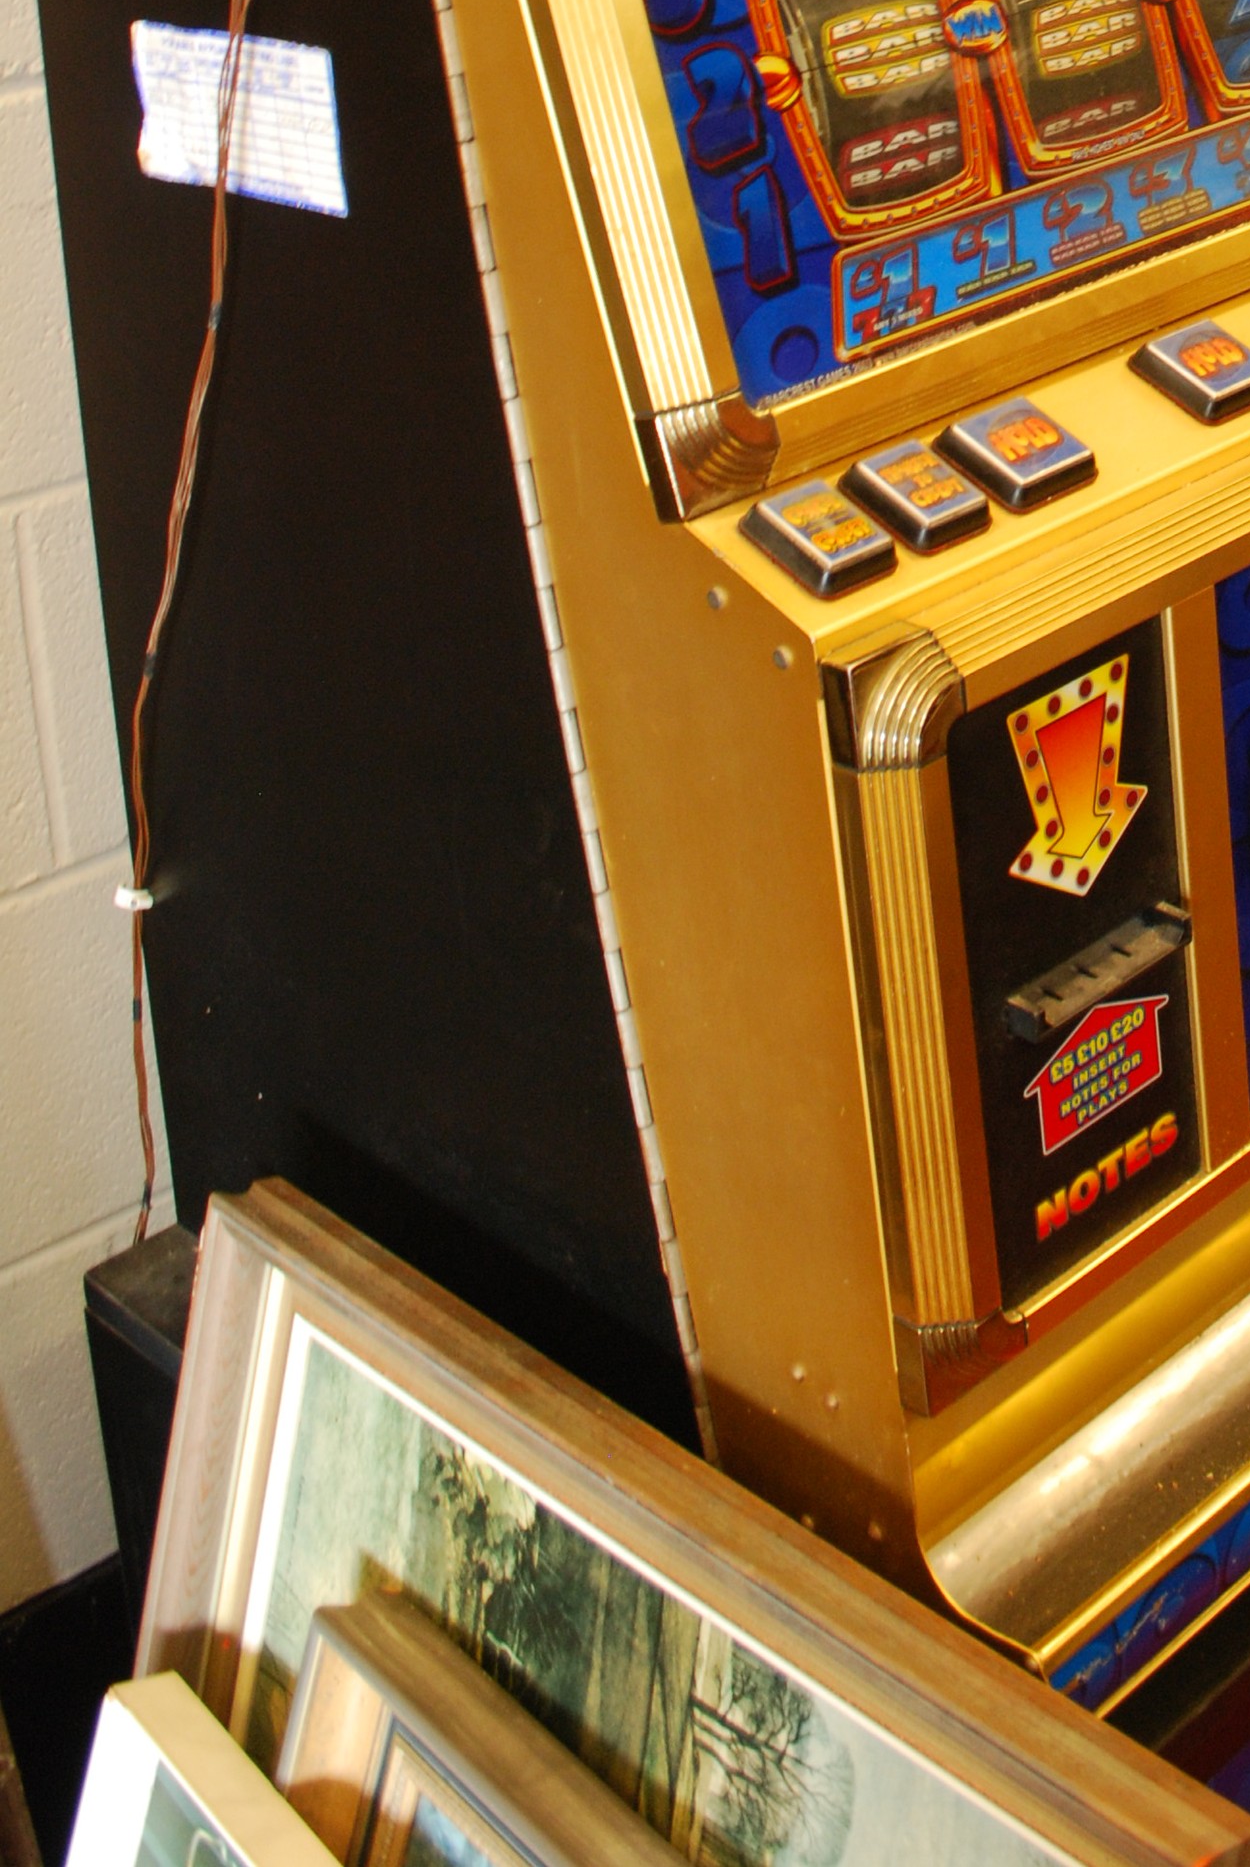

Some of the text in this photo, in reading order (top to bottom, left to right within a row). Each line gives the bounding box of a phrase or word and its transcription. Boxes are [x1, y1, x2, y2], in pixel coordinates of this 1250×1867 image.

[831, 3, 939, 41] BAR
[945, 3, 1004, 47] WIN
[1040, 12, 1137, 50] BAR
[836, 27, 945, 67] BAR
[1044, 36, 1137, 74] BAR
[843, 52, 950, 92] BAR
[682, 43, 761, 170] 2
[1042, 98, 1137, 138] BAR
[851, 120, 958, 163] BAR
[850, 144, 958, 188] BAR
[733, 163, 794, 292] 1
[1179, 335, 1247, 379] HOLD
[987, 415, 1063, 463] HOLD
[1050, 1005, 1145, 1083] £5 £10 £20
[1072, 1042, 1127, 1090] INSERT
[1059, 1050, 1143, 1118] NOTES FOR
[1076, 1080, 1129, 1125] PLAYS
[1035, 1112, 1180, 1242] NOTES
